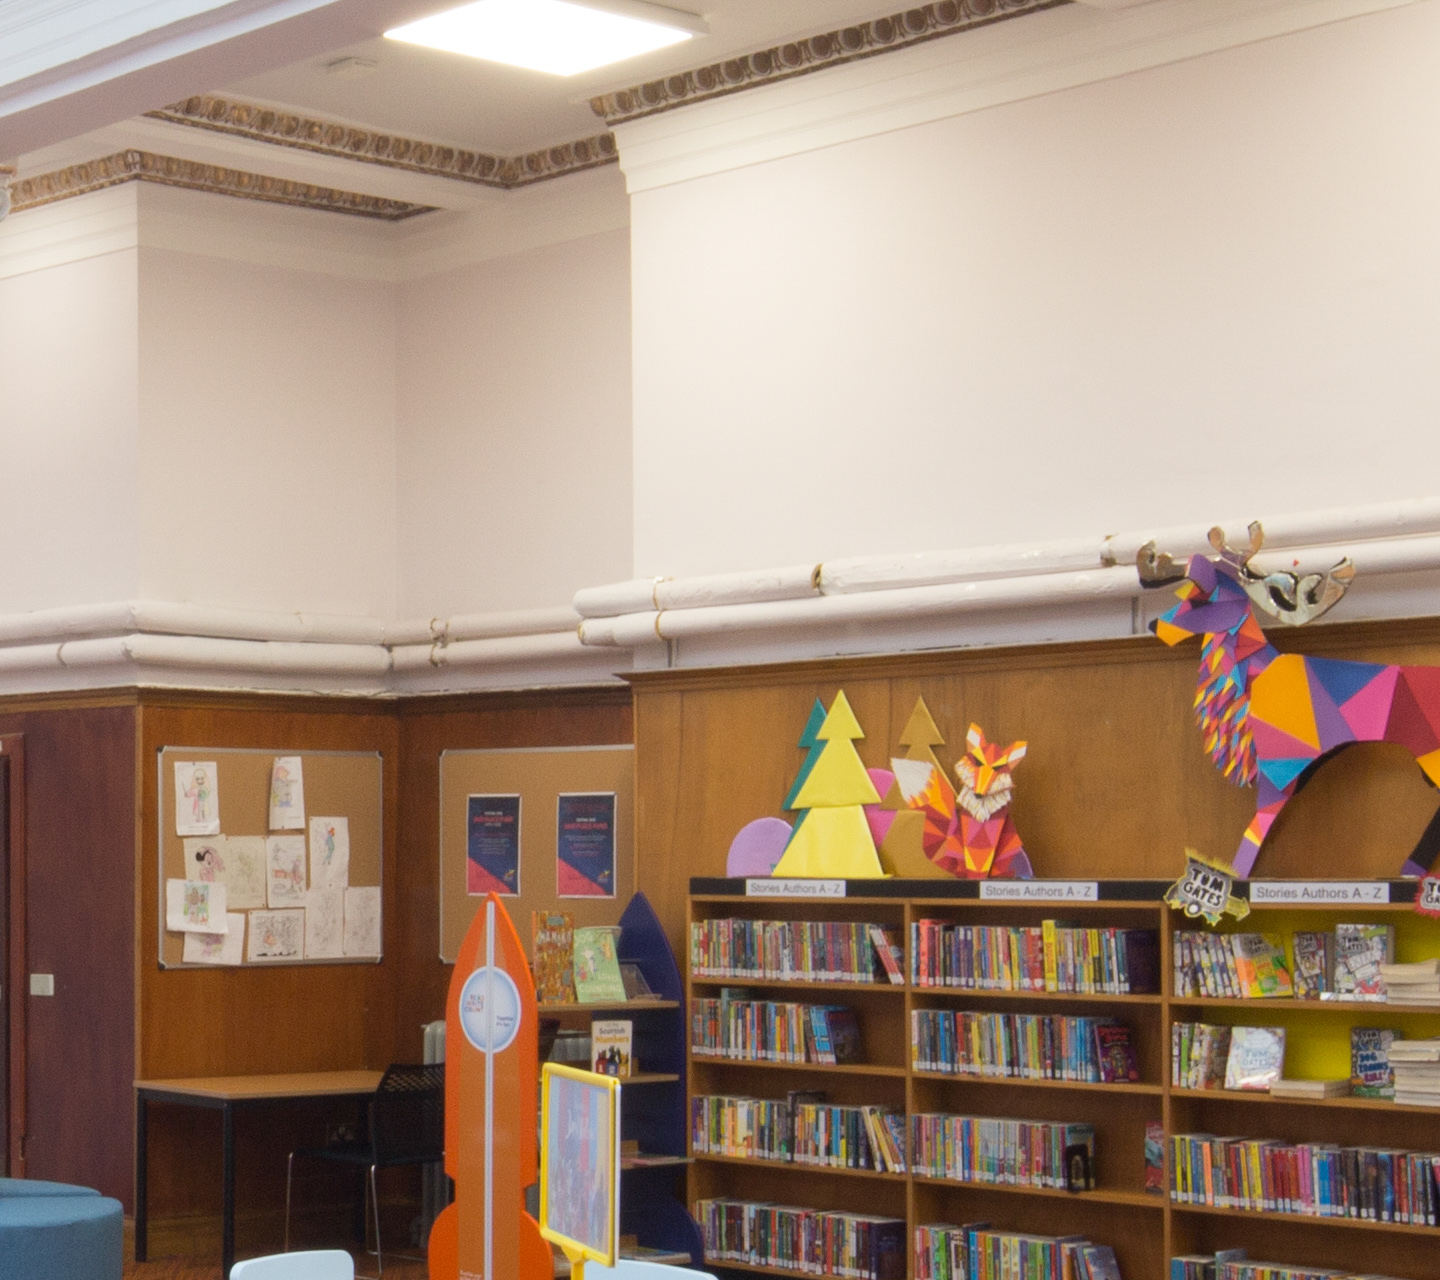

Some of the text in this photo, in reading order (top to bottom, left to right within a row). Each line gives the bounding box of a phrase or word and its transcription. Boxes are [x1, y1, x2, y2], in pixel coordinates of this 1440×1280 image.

[1191, 868, 1225, 891] TOM
[750, 883, 780, 894] Stories
[783, 883, 817, 894] Authors
[819, 884, 826, 894] A
[833, 884, 841, 894] Z
[985, 885, 1020, 897] Stories
[1023, 885, 1063, 897] Authors
[1067, 886, 1075, 897] A
[1083, 886, 1091, 897] Z
[1183, 881, 1224, 907] GATES
[1256, 887, 1297, 899] Stories
[1300, 887, 1348, 899] Authors
[1352, 887, 1363, 899] A
[1372, 888, 1382, 900] Z
[595, 1035, 629, 1043] Numbers
